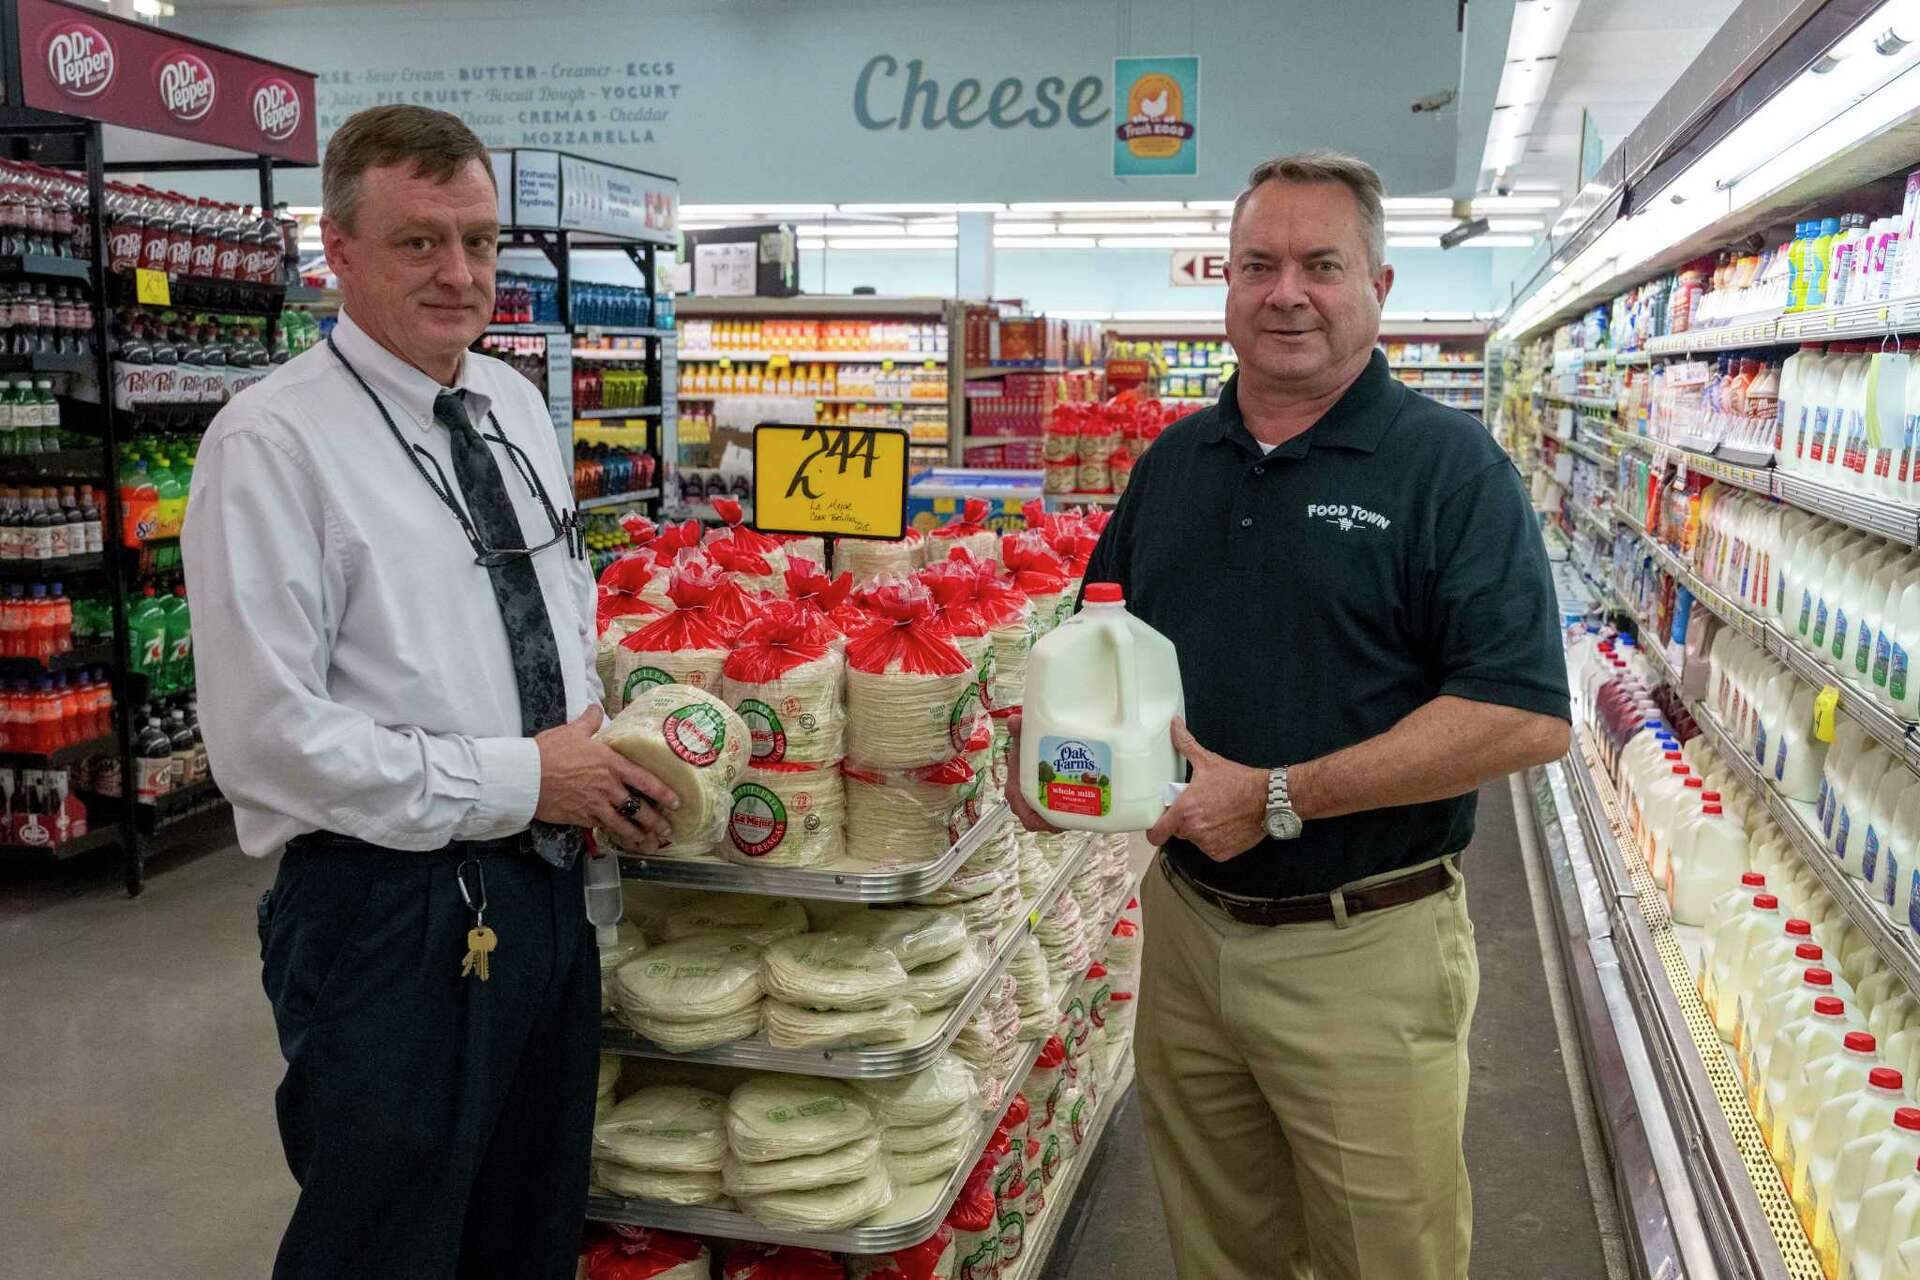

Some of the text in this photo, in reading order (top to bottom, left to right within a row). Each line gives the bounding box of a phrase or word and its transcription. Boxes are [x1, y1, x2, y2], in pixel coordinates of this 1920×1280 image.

[71, 31, 93, 56] Dr
[49, 33, 110, 88] Pepper
[179, 60, 197, 84] Dr
[401, 66, 445, 82] Cream
[458, 65, 537, 81] BUTTER
[551, 63, 611, 79] Creamer
[160, 63, 213, 112] Pepper
[270, 84, 286, 107] Dr
[376, 91, 405, 104] PIE
[411, 90, 473, 104] CRUST
[539, 86, 586, 106] Dough
[601, 84, 681, 99] YOGURT
[854, 53, 1111, 131] Cheese
[254, 87, 298, 132] Pepper
[517, 110, 597, 124] CREMAS
[610, 107, 670, 123] Cheddar
[522, 130, 654, 145] MOZZARELLA
[1307, 504, 1392, 530] FOOD TOWN
[1060, 746, 1090, 761] Oak
[1053, 759, 1095, 773] Farms
